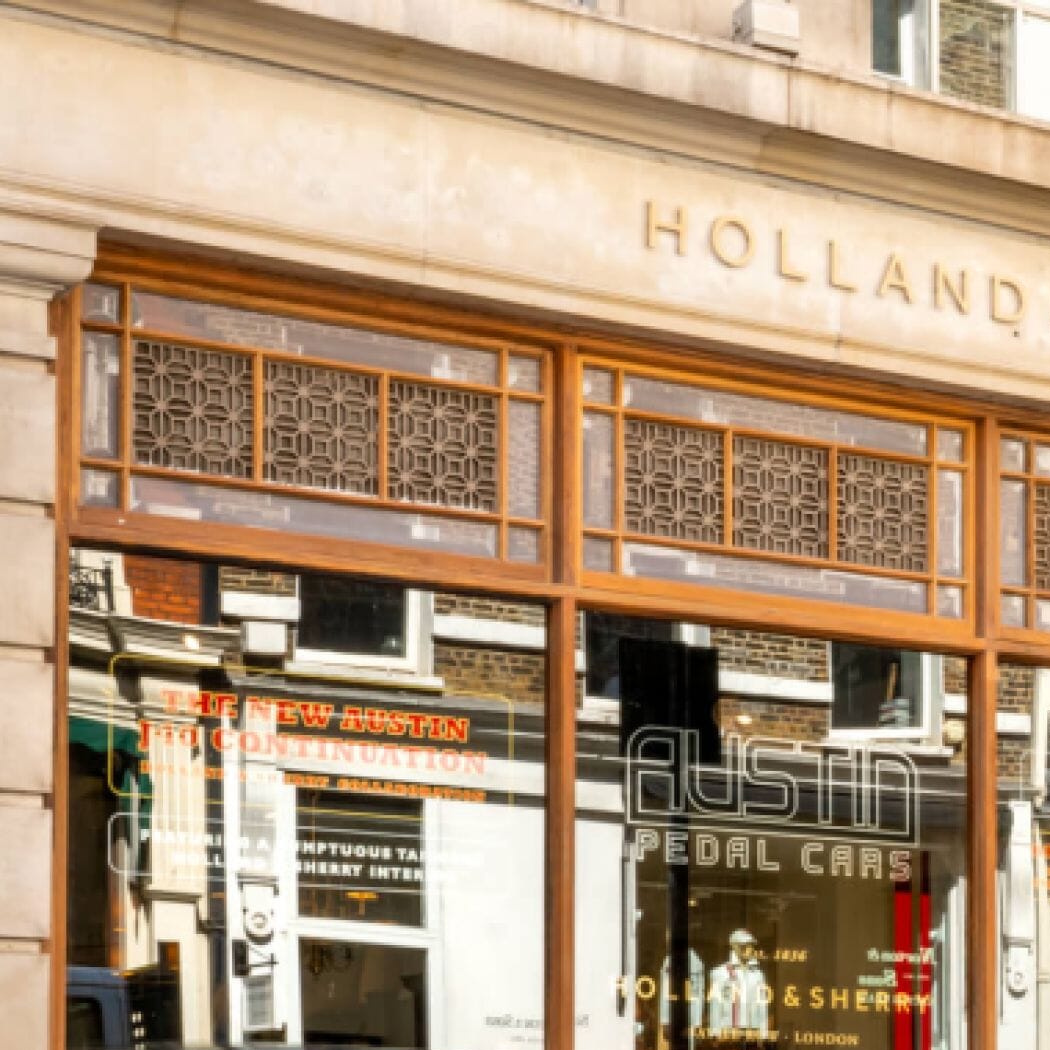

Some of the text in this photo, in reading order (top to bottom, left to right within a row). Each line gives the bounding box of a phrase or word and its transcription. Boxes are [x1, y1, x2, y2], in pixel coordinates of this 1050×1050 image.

[643, 200, 1026, 327] HOLLAND
[161, 690, 471, 744] THE NEW AUSTIN
[211, 728, 490, 775] CONTINUATION
[626, 725, 921, 848] AUSTIN
[634, 828, 913, 882] PEDAL CARS
[784, 984, 801, 1008] &
[808, 984, 933, 1015] SHERRY
[795, 1031, 860, 1046] LONDON
